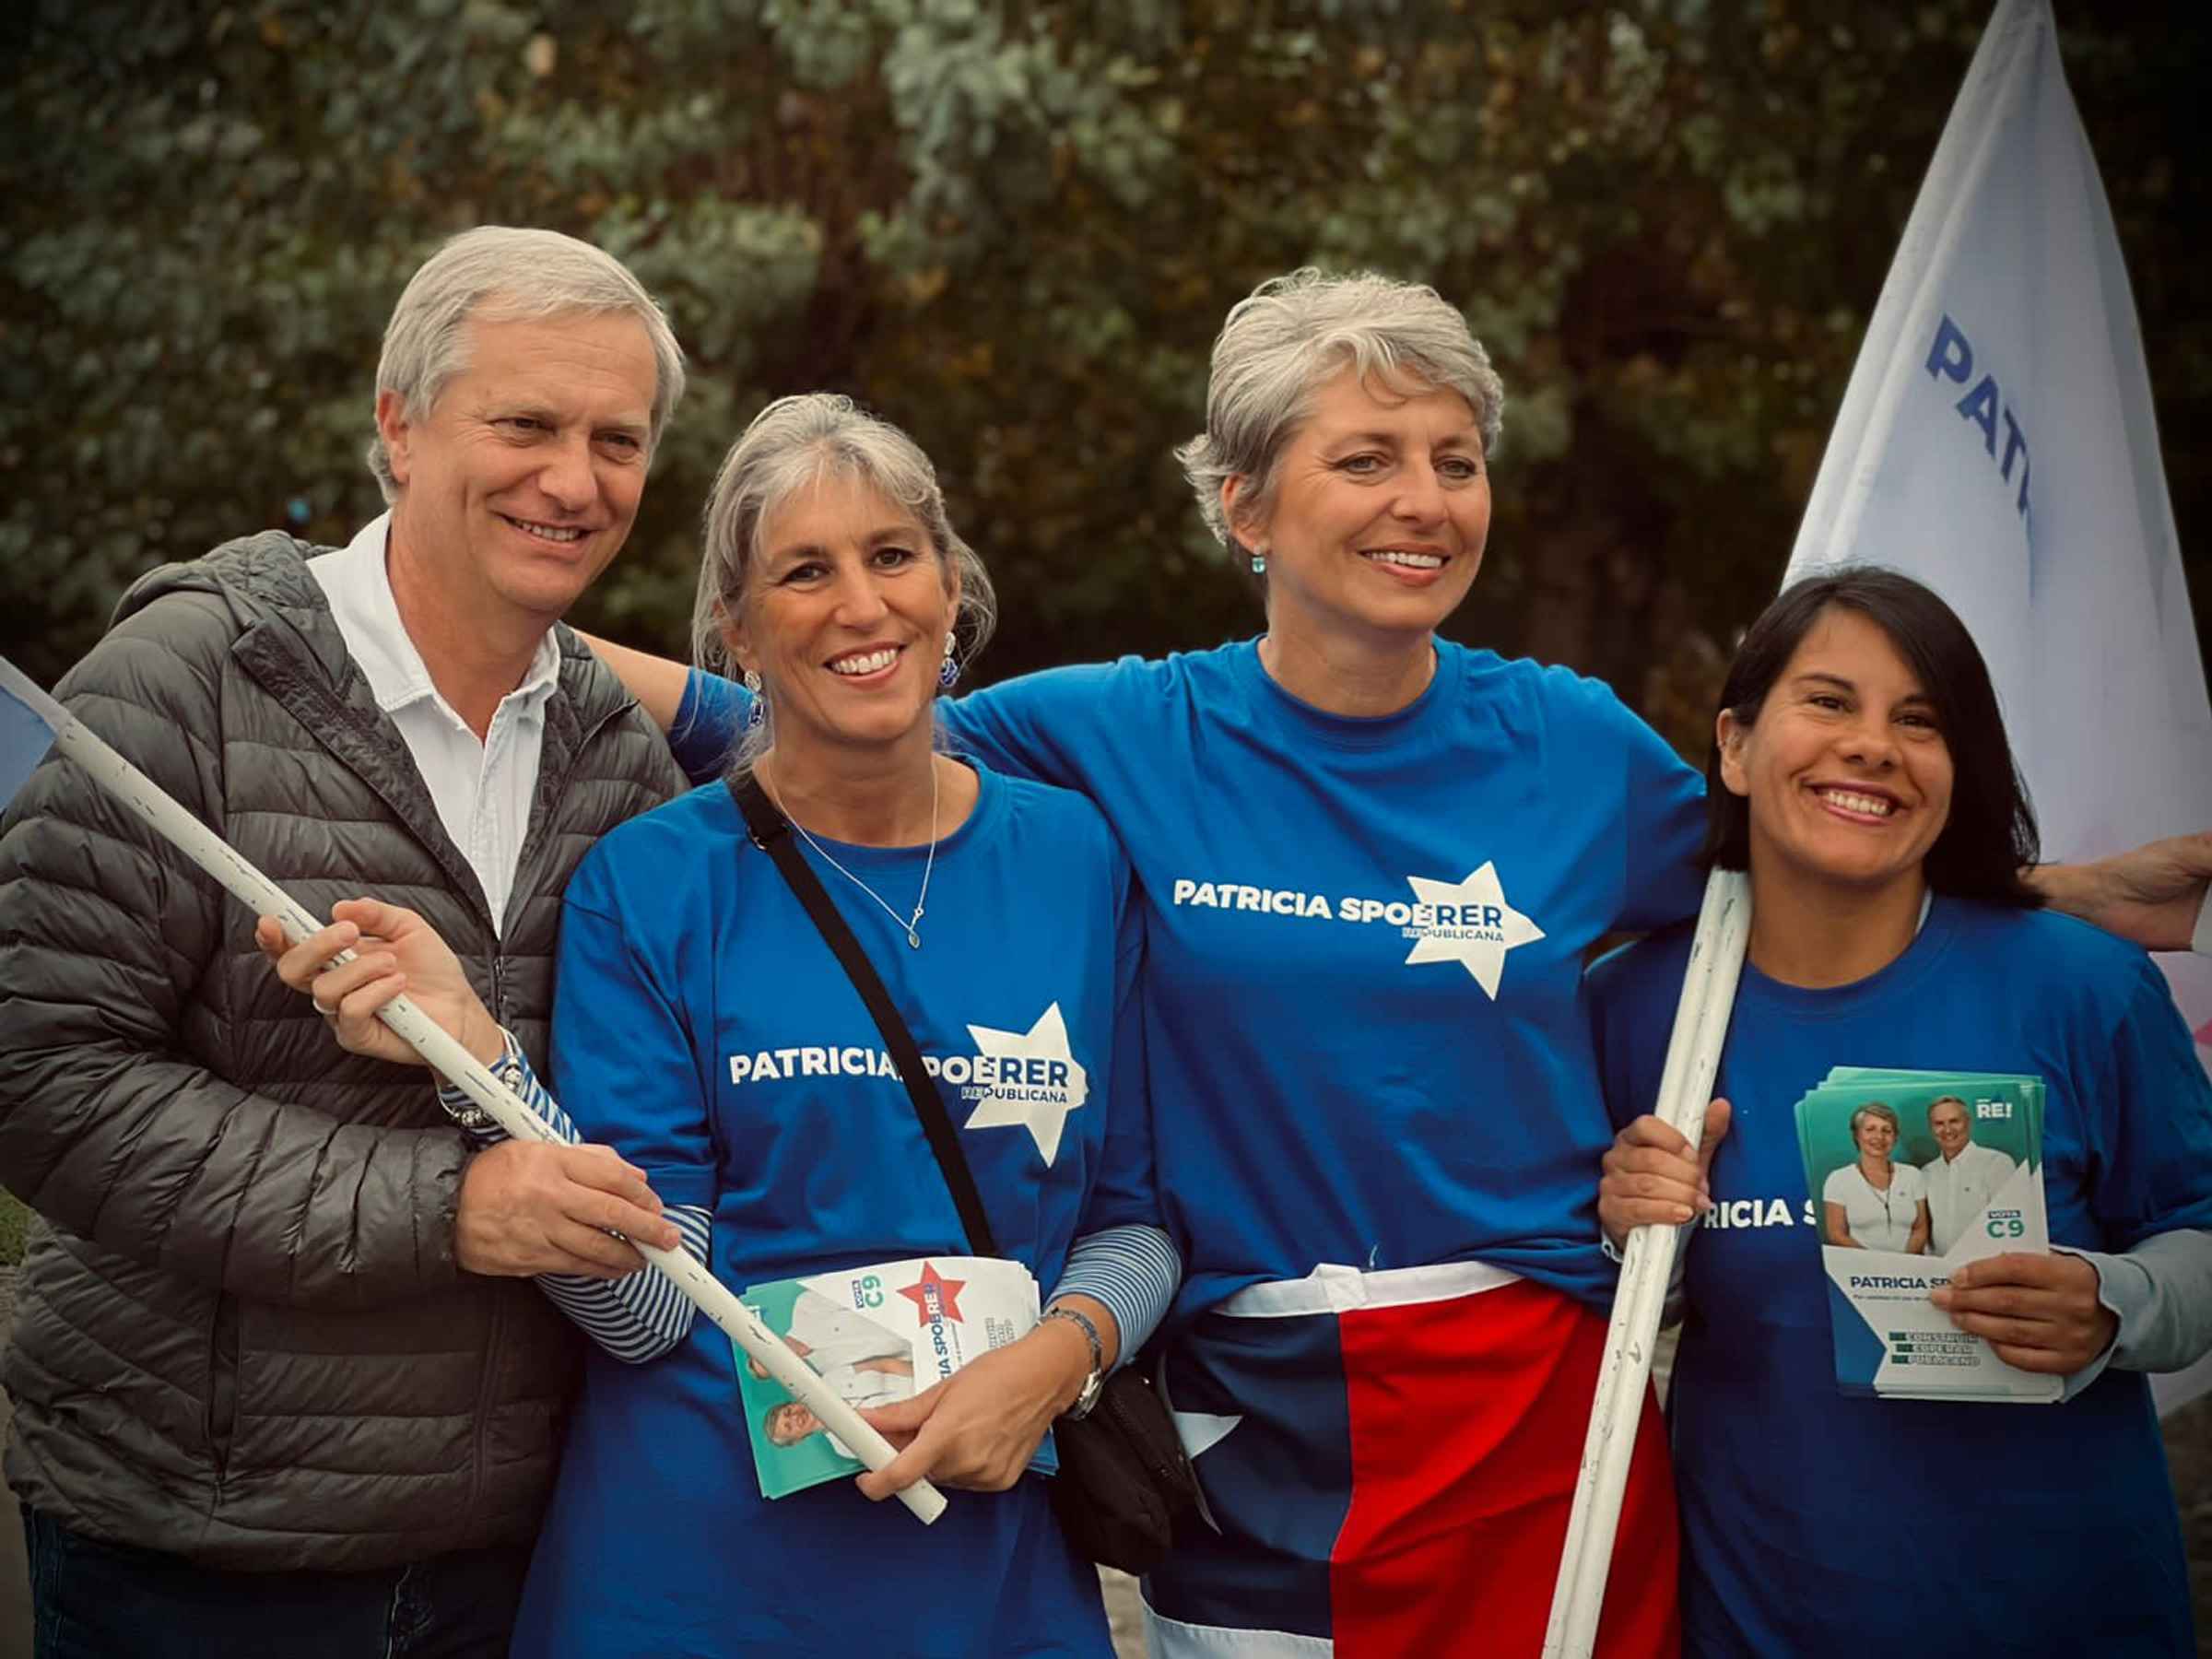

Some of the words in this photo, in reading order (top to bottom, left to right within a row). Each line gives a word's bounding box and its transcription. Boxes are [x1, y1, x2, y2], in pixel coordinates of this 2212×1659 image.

[1924, 312, 2030, 519] PAT
[1173, 878, 1333, 920] PATRICIA
[1338, 896, 1503, 929] SPOERER
[729, 1045, 898, 1085] PATRICIA
[900, 1054, 1068, 1088] POERER
[1703, 1198, 1794, 1229] RICIA
[1986, 1219, 2025, 1239] C9
[862, 1275, 884, 1309] C9
[1851, 1276, 1928, 1289] PATRICIA
